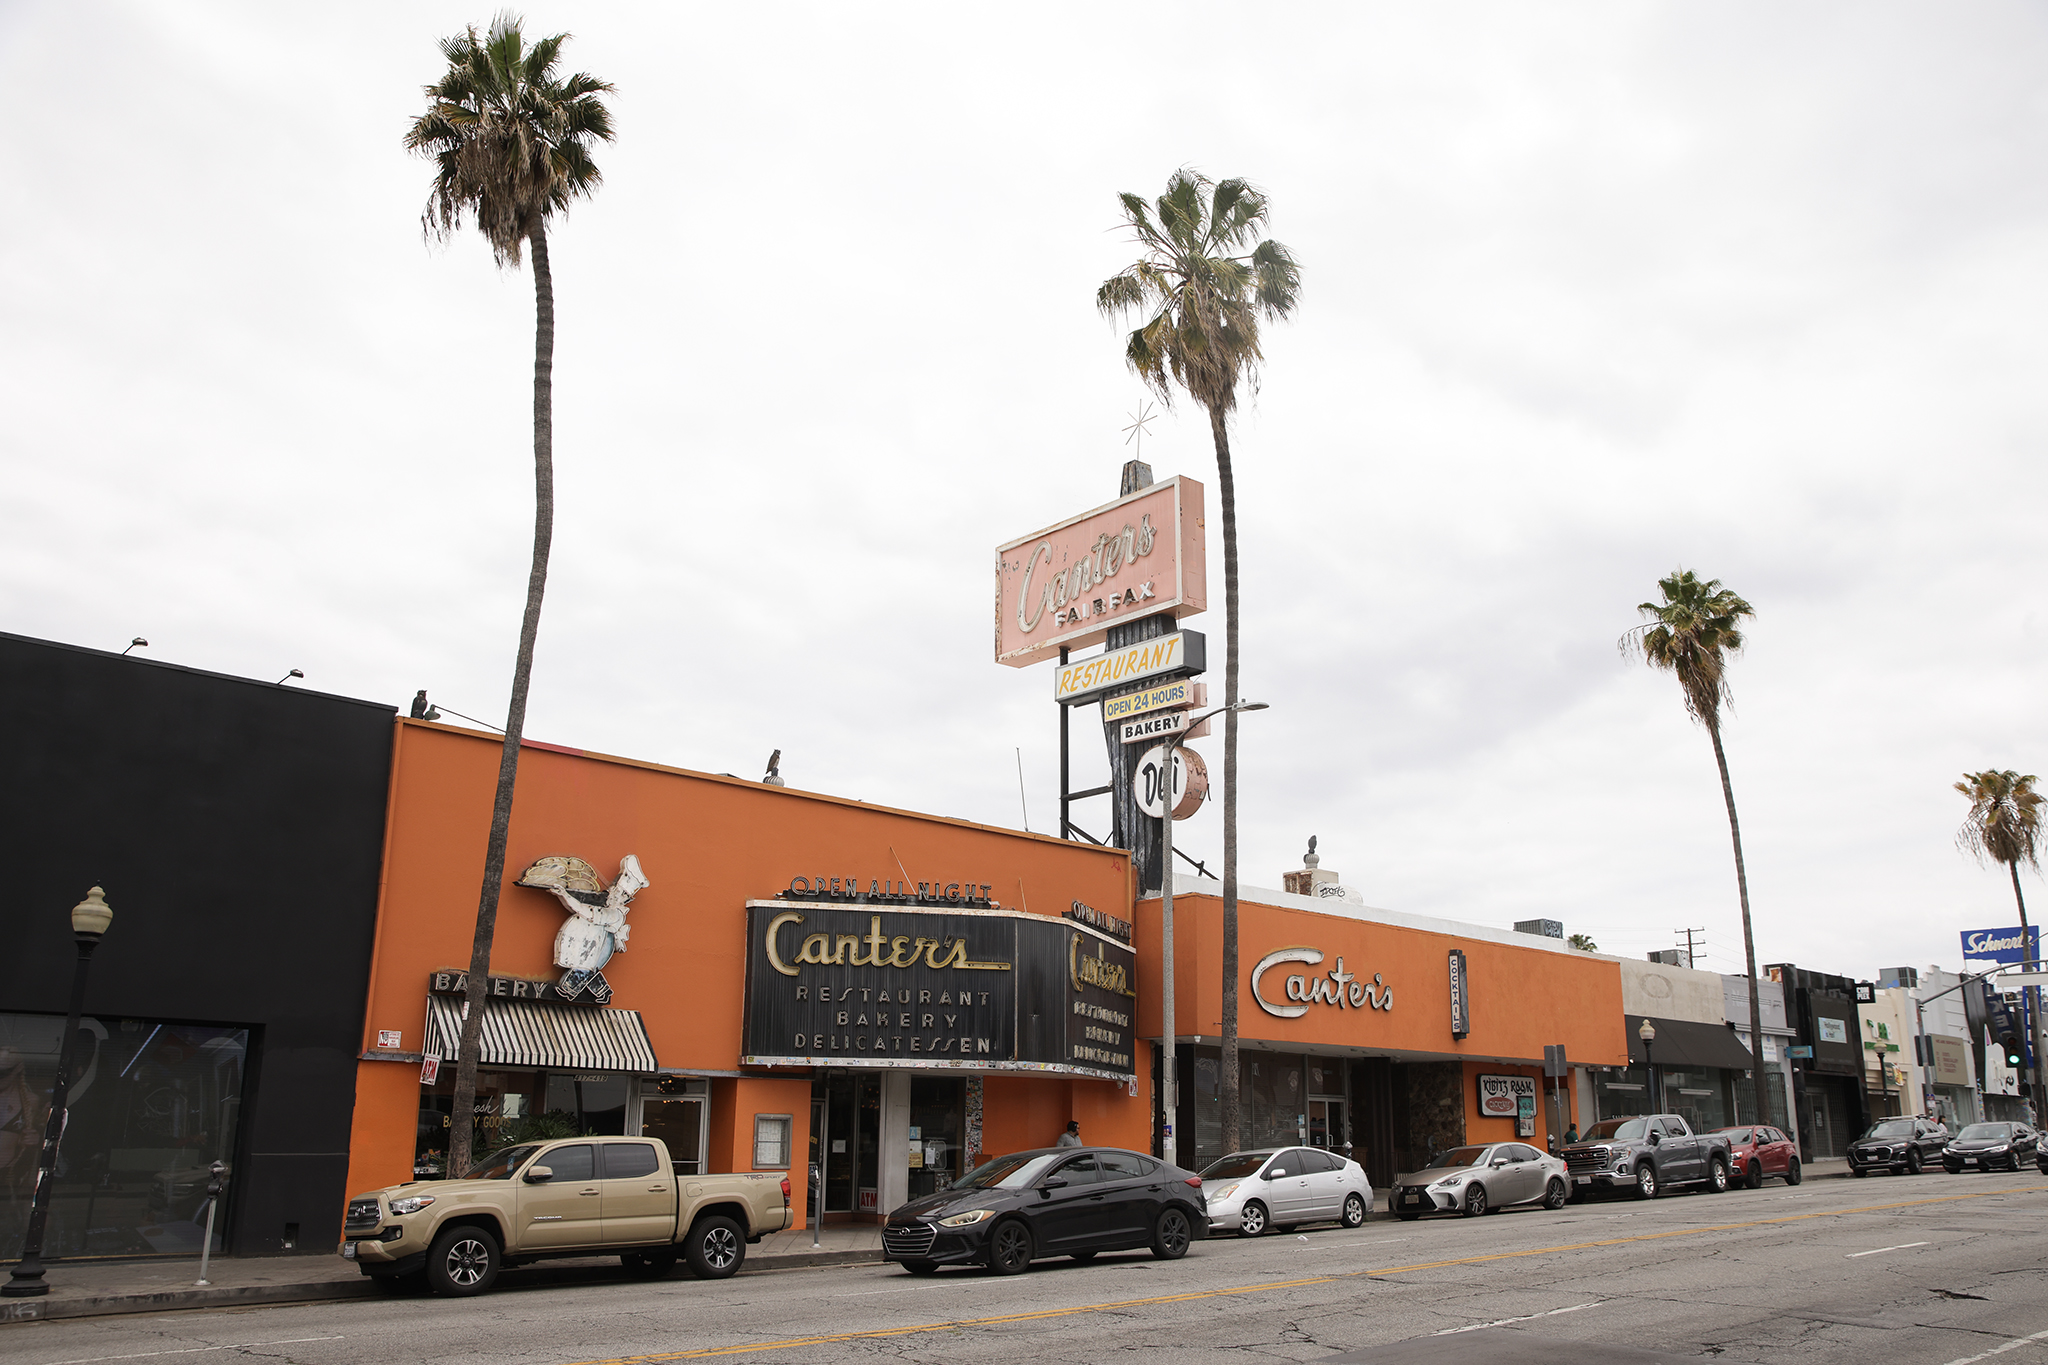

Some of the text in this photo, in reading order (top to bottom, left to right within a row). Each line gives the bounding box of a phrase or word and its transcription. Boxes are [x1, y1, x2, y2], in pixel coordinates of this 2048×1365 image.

[1055, 581, 1155, 627] FAIRFAX
[1059, 637, 1180, 695] RESTAURANT
[1107, 686, 1185, 717] OPEN 24 HOURS
[1125, 715, 1181, 739] BAKERY
[790, 876, 992, 903] OPEN ALL NIGHT
[1071, 900, 1132, 939] OPEN ALL NIGHT
[766, 912, 1011, 977] Canter's
[435, 973, 549, 999] BAERY
[796, 985, 990, 1006] RESTAURANT
[1251, 947, 1394, 1018] Canter's
[1451, 959, 1461, 1030] COCKTAILS
[837, 1010, 957, 1028] BAKERY
[794, 1033, 991, 1054] DELICATESSEN
[421, 1059, 438, 1080] ATM
[860, 1191, 877, 1208] ATM
